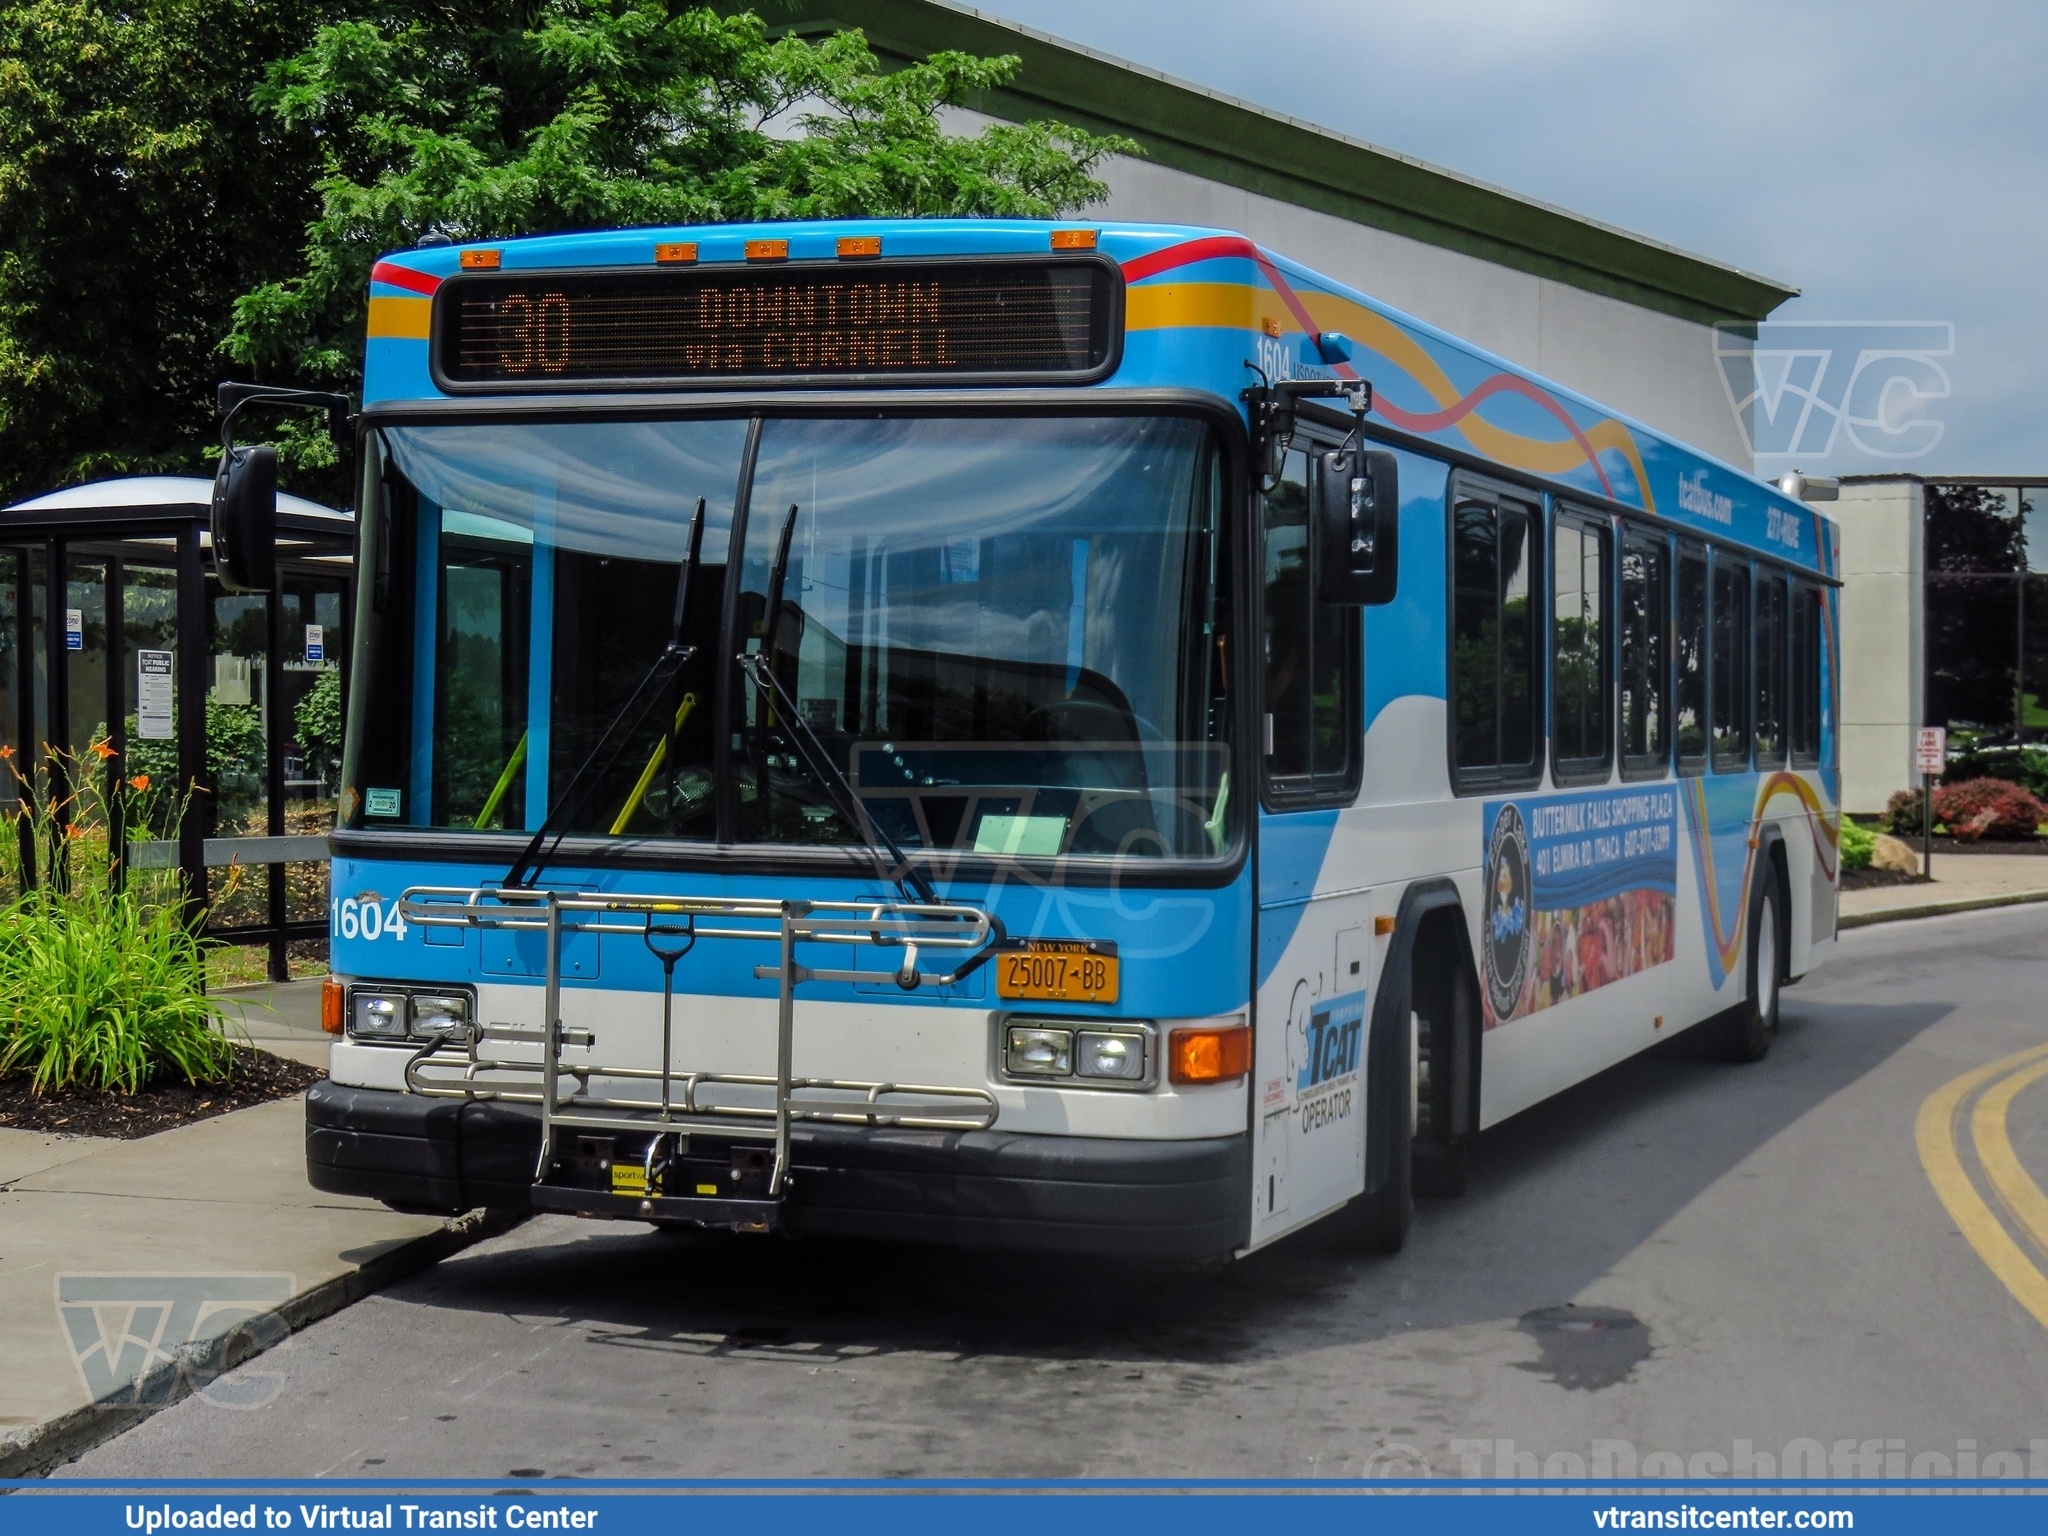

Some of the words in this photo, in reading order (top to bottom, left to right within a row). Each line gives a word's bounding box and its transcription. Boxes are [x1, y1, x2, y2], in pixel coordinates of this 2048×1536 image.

[501, 293, 570, 373] 30
[699, 282, 939, 329] DOWNTOWN
[686, 334, 740, 369] via
[763, 328, 957, 368] CORNELL
[1257, 336, 1291, 382] 1604
[153, 659, 170, 667] PUBLIC
[1532, 803, 1585, 839] BUTTERMILK
[1587, 799, 1610, 830] FALLS
[1612, 796, 1650, 826] SHOPPING
[1651, 793, 1673, 820] PLAZA
[1595, 835, 1620, 865] ITHACA
[332, 897, 408, 941] 1604
[1027, 942, 1056, 953] NEW
[1059, 943, 1089, 954] YORK
[1310, 1010, 1362, 1087] TCAT
[1301, 1088, 1351, 1134] OPERATOR
